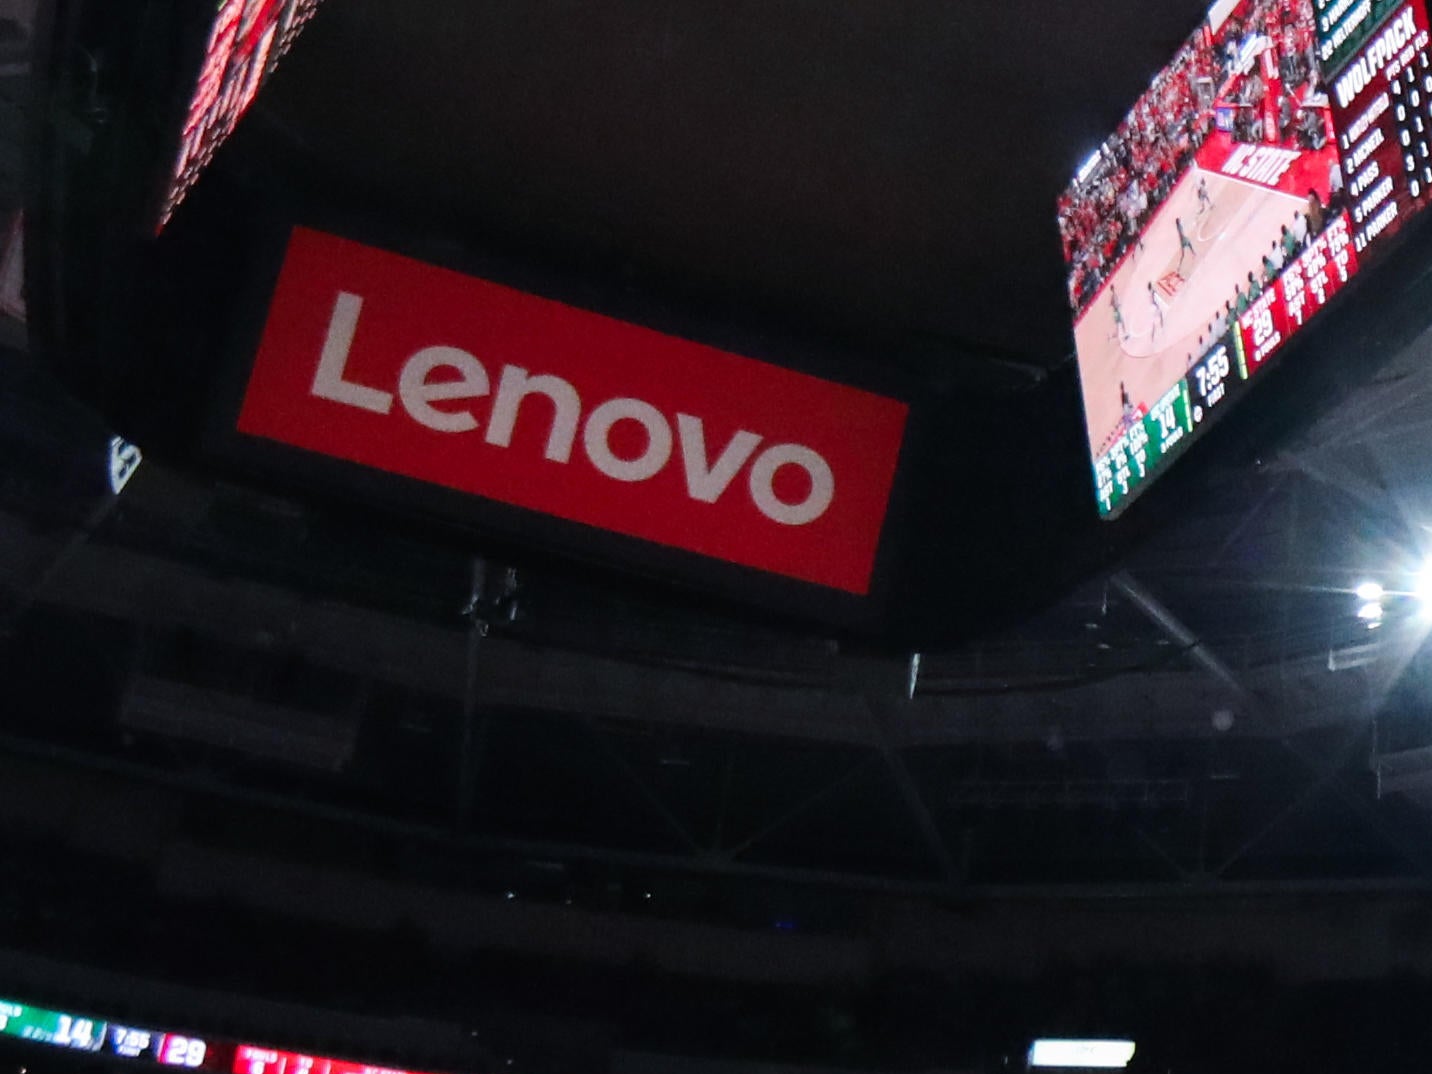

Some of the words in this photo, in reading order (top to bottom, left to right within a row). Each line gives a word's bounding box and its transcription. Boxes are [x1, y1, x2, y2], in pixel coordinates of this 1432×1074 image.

[1335, 6, 1418, 108] WOLFPACK
[1407, 66, 1415, 83] 1
[1421, 52, 1429, 68] 1
[1345, 158, 1355, 174] 2
[1397, 104, 1406, 121] 0
[1411, 90, 1420, 107] 0
[1357, 161, 1380, 192] PASS
[1402, 129, 1411, 146] 0
[1416, 116, 1424, 133] 1
[1354, 206, 1363, 223] 5
[1362, 176, 1394, 216] PARKER
[1405, 154, 1415, 172] 3
[1421, 141, 1429, 157] 1
[1354, 233, 1367, 252] 11
[1366, 201, 1398, 242] PARKER
[1411, 180, 1420, 197] 0
[1252, 308, 1274, 346] 29
[1195, 344, 1230, 397] 7:55
[309, 292, 836, 526] Lenovo
[1158, 404, 1176, 439] 14
[53, 1013, 94, 1047] 14
[169, 1035, 207, 1067] 29
